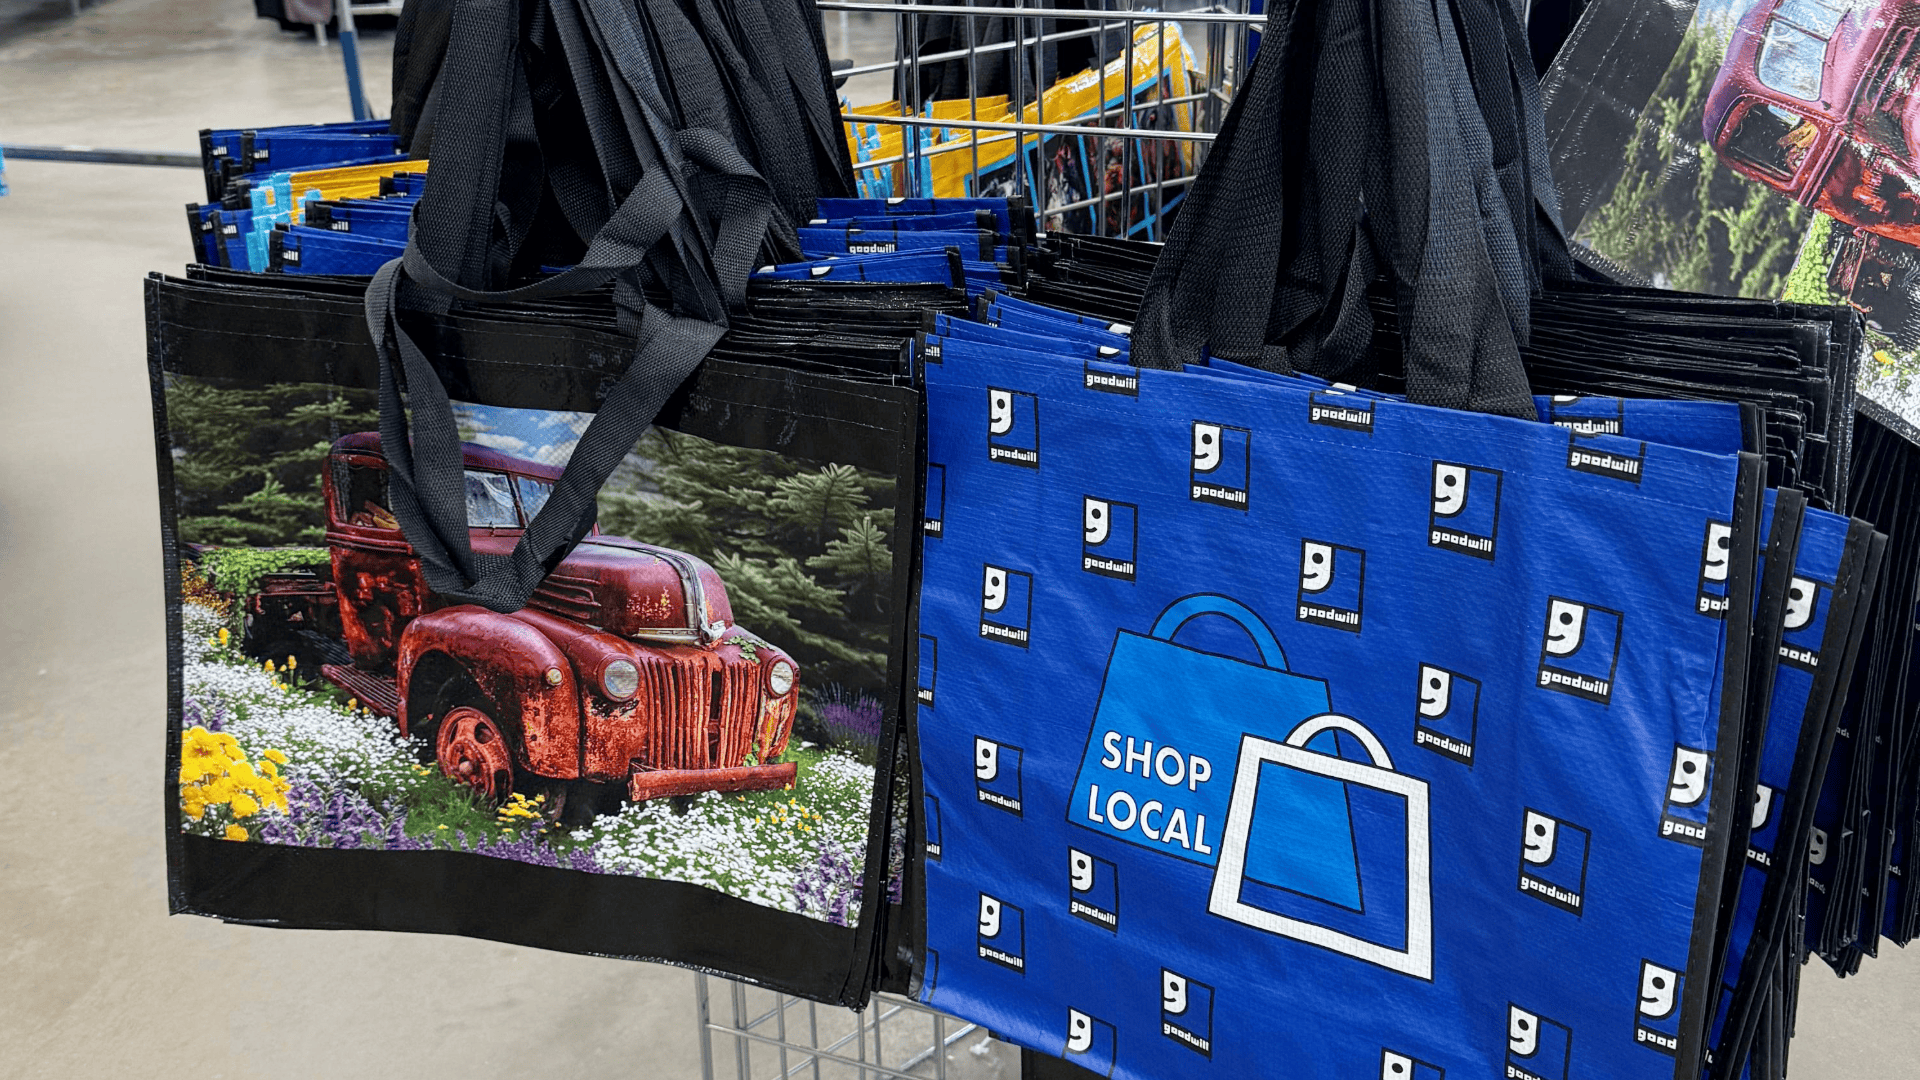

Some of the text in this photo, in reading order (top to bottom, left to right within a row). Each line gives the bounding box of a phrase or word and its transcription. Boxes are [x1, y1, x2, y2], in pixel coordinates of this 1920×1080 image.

[1087, 375, 1136, 389] goodwill
[1312, 407, 1370, 424] goodwill
[991, 448, 1036, 462] goodwill
[1571, 452, 1638, 474] goodwill
[1193, 486, 1245, 503] goodwill
[1432, 531, 1492, 552] goodwill
[1085, 558, 1133, 574] goodwill
[1300, 606, 1358, 624] goodwill
[982, 624, 1027, 641] goodwill
[1541, 671, 1608, 695] goodwill
[1417, 731, 1471, 757] goodwill
[1102, 731, 1212, 790] SHOP
[979, 790, 1020, 810] goodwill
[1088, 784, 1212, 855] LOCAL
[1663, 820, 1706, 839] good
[1521, 877, 1579, 907] goodwill
[1071, 902, 1115, 925] goodwill
[980, 947, 1022, 967] goodwill
[1164, 1024, 1209, 1051] goodwill
[1638, 1029, 1677, 1049] good
